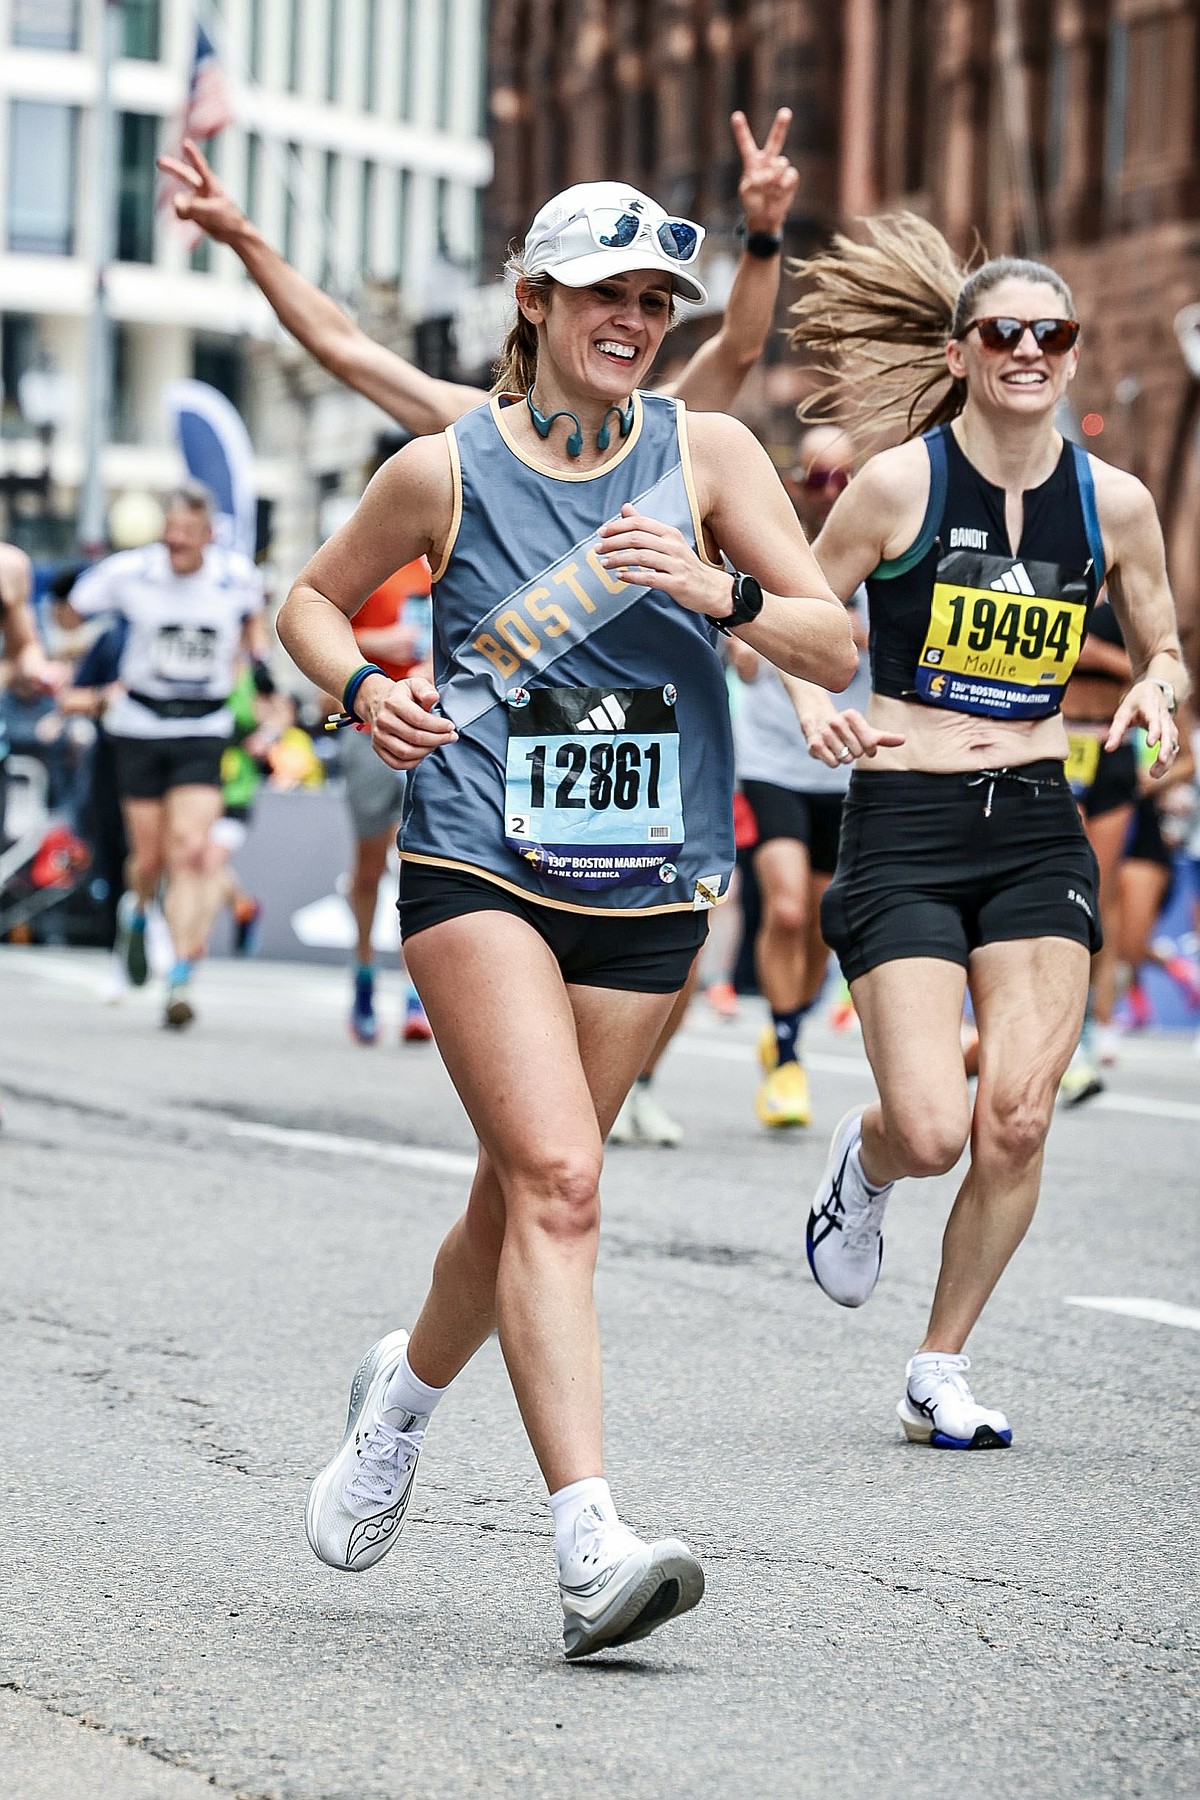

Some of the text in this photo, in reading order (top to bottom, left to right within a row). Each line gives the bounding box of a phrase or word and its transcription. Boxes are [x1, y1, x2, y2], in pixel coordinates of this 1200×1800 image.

[950, 527, 989, 550] BANDIT
[472, 547, 650, 680] BOSTO
[947, 596, 1073, 662] 19494
[926, 649, 942, 663] 6
[963, 655, 1017, 676] Mollie
[970, 685, 1006, 699] BOSTON
[1007, 690, 1050, 704] MARATHON
[525, 741, 661, 811] 12861
[511, 817, 525, 834] 2
[571, 856, 613, 869] BOSTON
[614, 856, 667, 869] MARATHON
[584, 871, 620, 879] AMERICA
